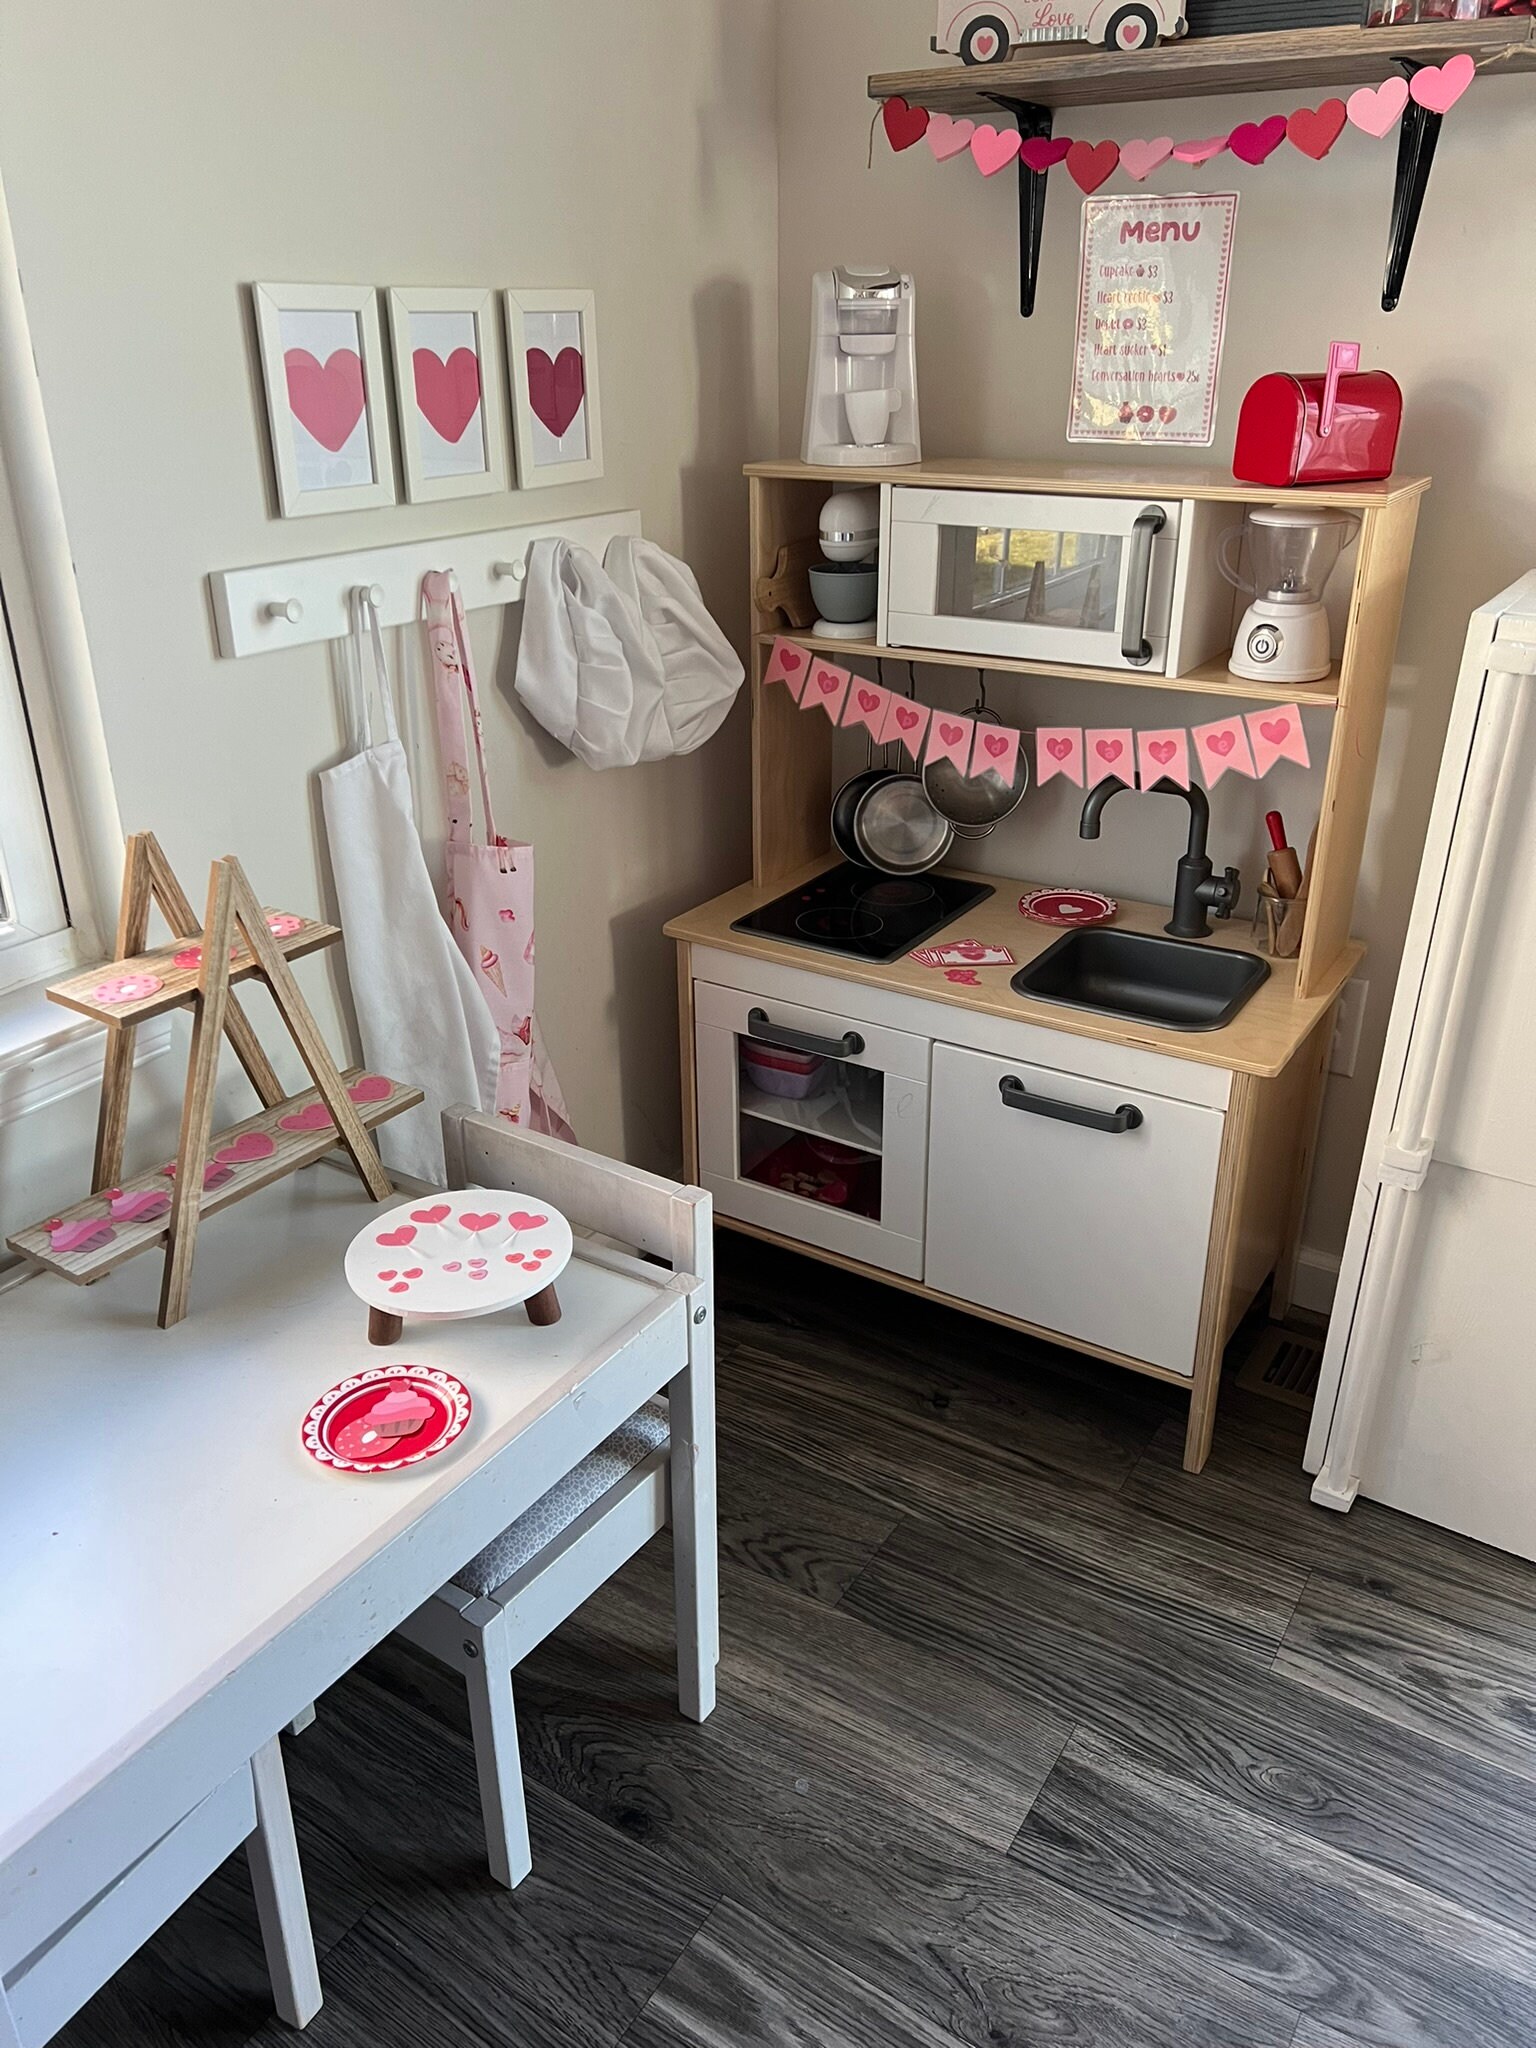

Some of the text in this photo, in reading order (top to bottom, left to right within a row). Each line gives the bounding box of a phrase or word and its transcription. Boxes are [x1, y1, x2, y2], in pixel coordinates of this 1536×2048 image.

[1032, 3, 1074, 27] Love
[1120, 219, 1201, 245] Menu
[1099, 264, 1159, 279] Cupcake $3
[1096, 290, 1120, 304] Heart
[1162, 290, 1174, 304] $3
[1093, 343, 1117, 356] Heart
[1119, 344, 1148, 356] sucker
[1091, 369, 1145, 382] Conversation
[1148, 369, 1176, 383] hearts
